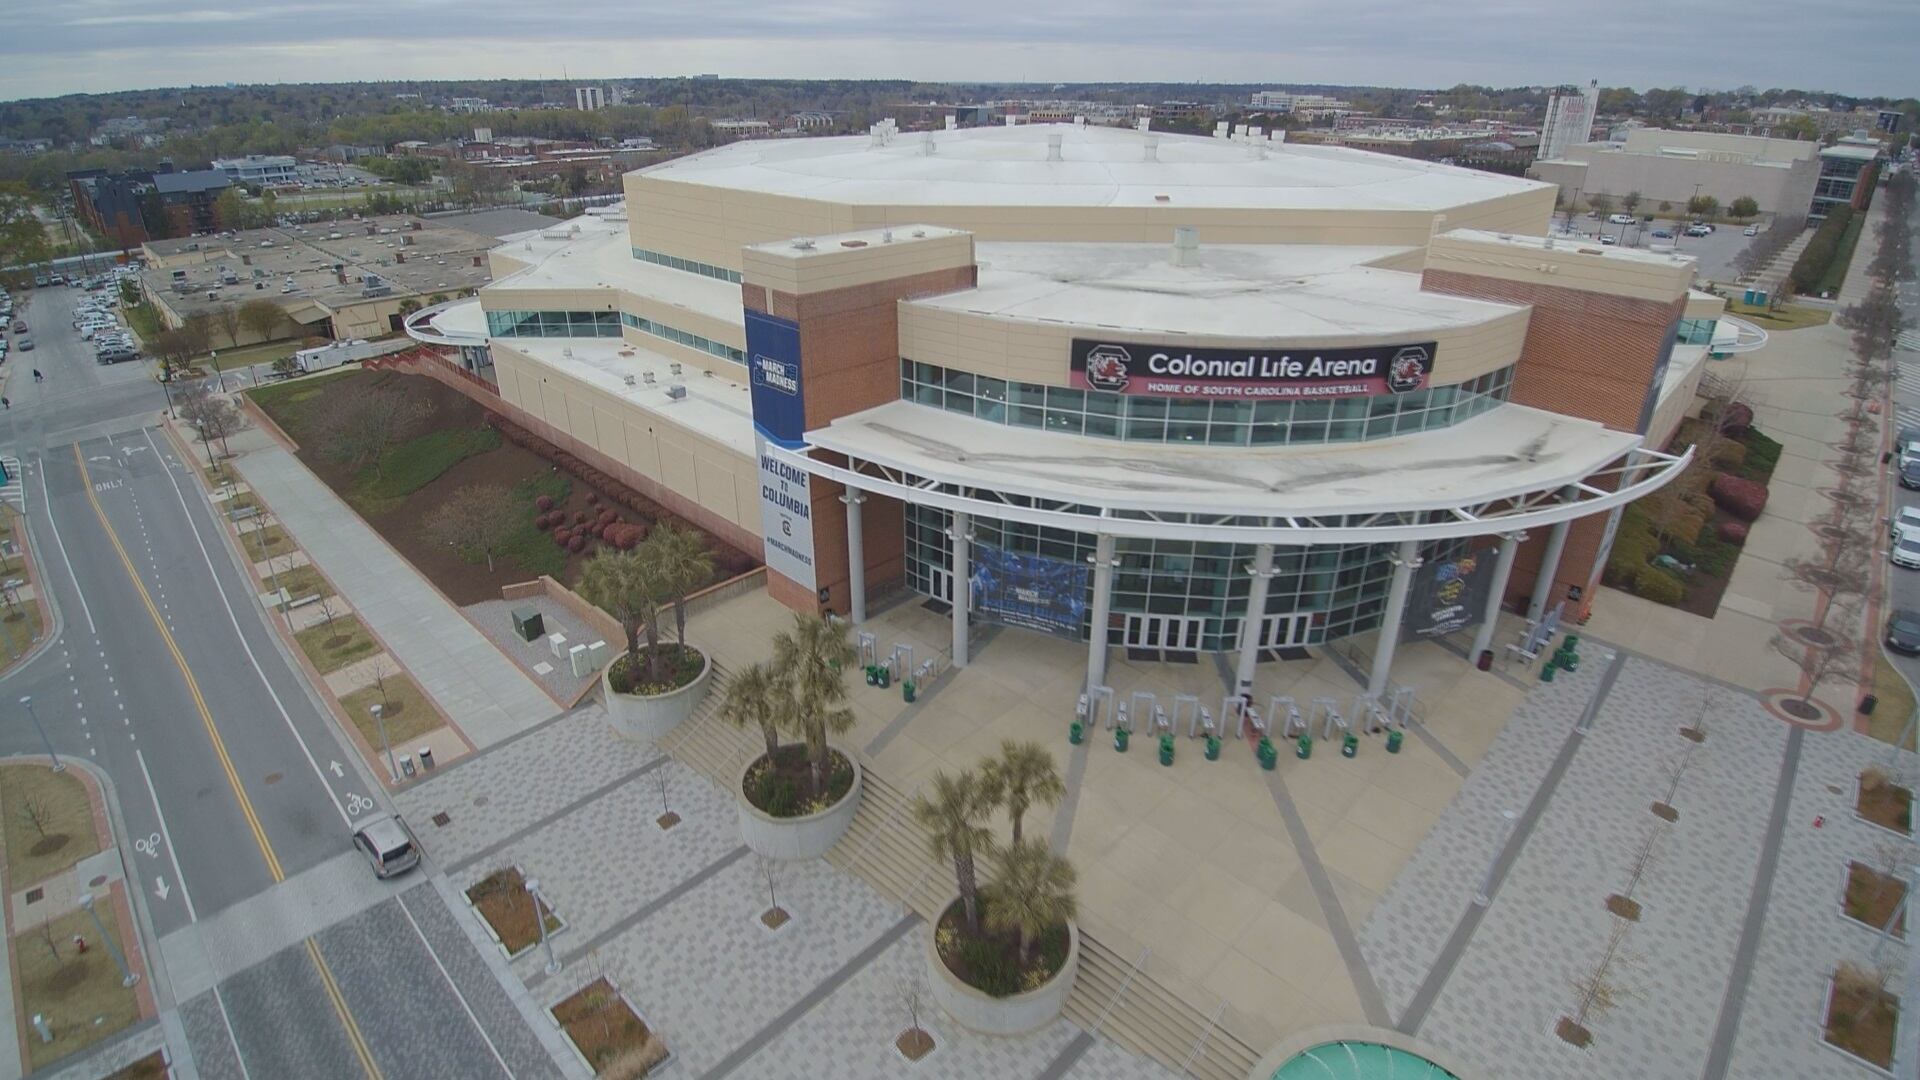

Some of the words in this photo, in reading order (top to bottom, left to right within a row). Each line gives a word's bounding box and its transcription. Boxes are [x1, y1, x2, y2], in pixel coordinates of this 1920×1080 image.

[762, 358, 785, 376] MARCH
[1148, 353, 1255, 377] Colonial
[1260, 356, 1303, 377] Life
[1304, 356, 1378, 377] Arena
[765, 371, 798, 391] MADNESS
[1148, 383, 1181, 393] HOME
[1183, 385, 1199, 394] OF
[1202, 386, 1242, 395] SOUTH
[1244, 386, 1300, 395] CAROLINA
[1303, 384, 1368, 395] BASKETBALL
[760, 454, 806, 488] WELCOME
[95, 479, 123, 491] ONLY
[780, 480, 789, 492] TO
[762, 484, 809, 520] COLUMBIA
